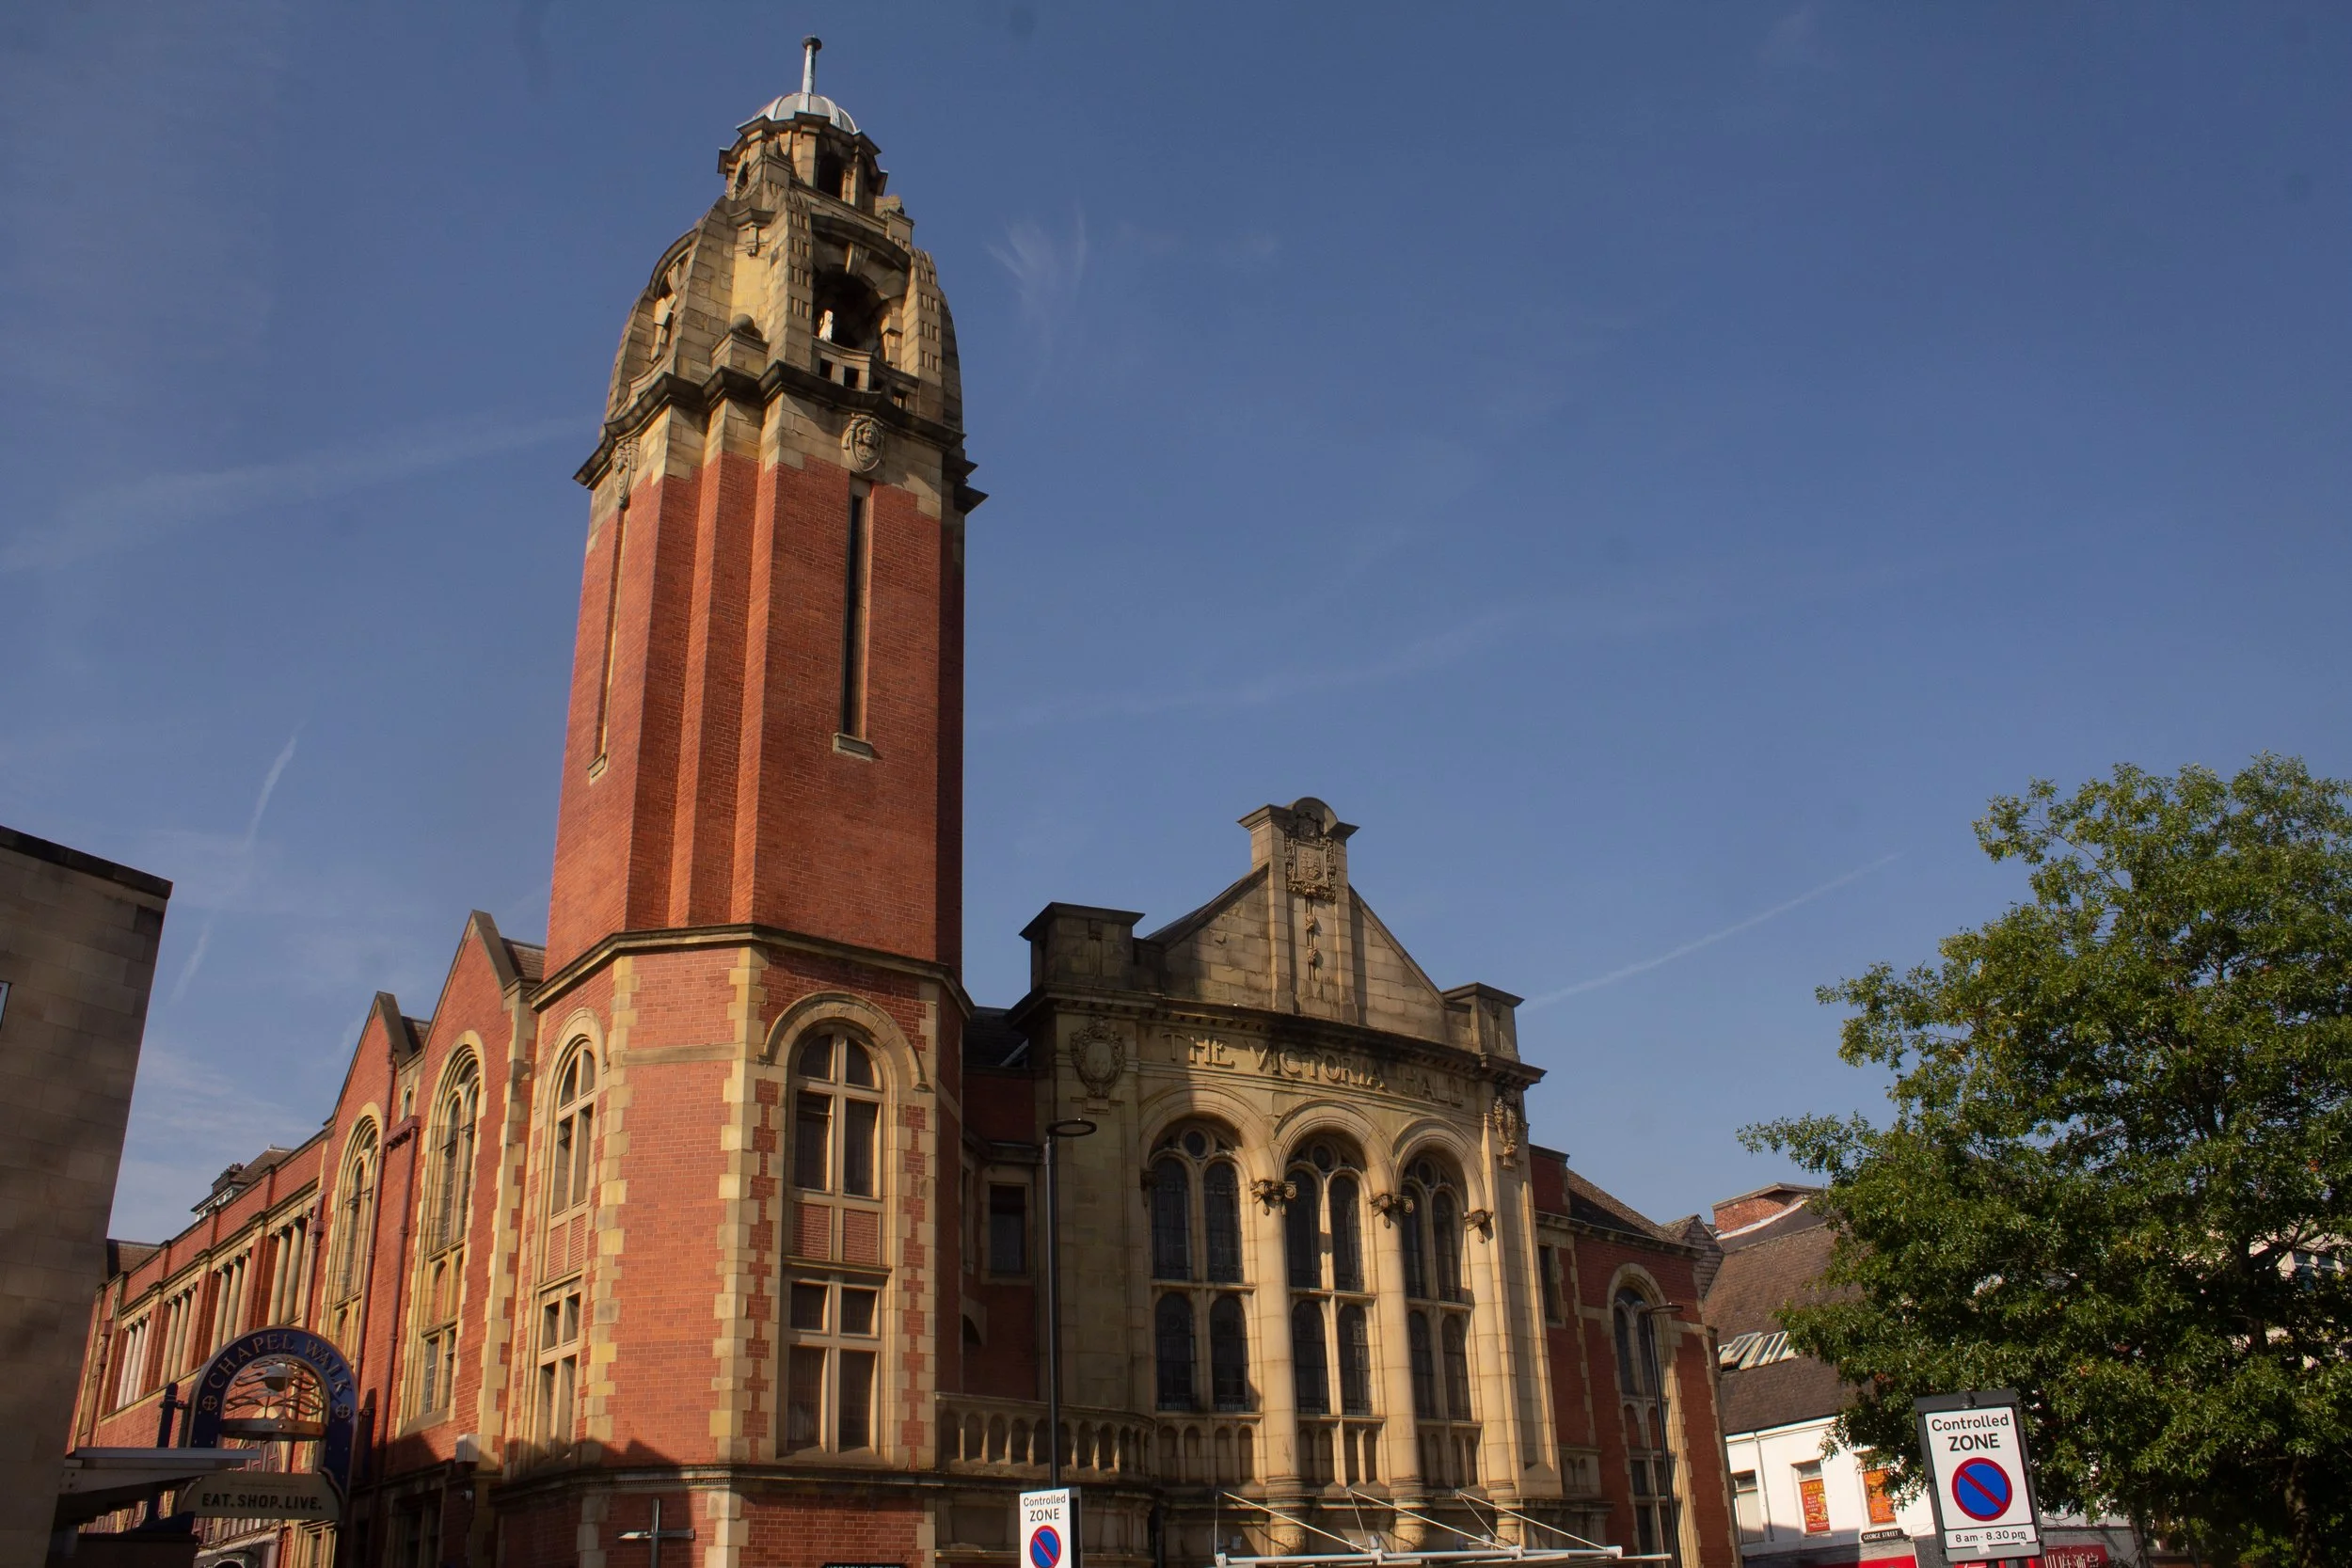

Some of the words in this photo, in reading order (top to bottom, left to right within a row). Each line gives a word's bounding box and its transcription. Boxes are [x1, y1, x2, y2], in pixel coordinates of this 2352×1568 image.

[1160, 1032, 1235, 1068] THE
[1247, 1042, 1386, 1088] VICTORIA
[208, 1333, 294, 1390] CHAPEL
[304, 1338, 354, 1398] WALK
[1931, 1413, 2010, 1432] Controlled
[1947, 1433, 2001, 1452] ZONE
[1024, 1493, 1066, 1507] Controlled
[1029, 1508, 1060, 1522] ZONE
[1882, 1529, 1899, 1538] STREET
[1955, 1533, 1962, 1543] 8
[1963, 1534, 1979, 1543] am
[1986, 1529, 2010, 1541] 8.30
[2011, 1530, 2026, 1540] pm
